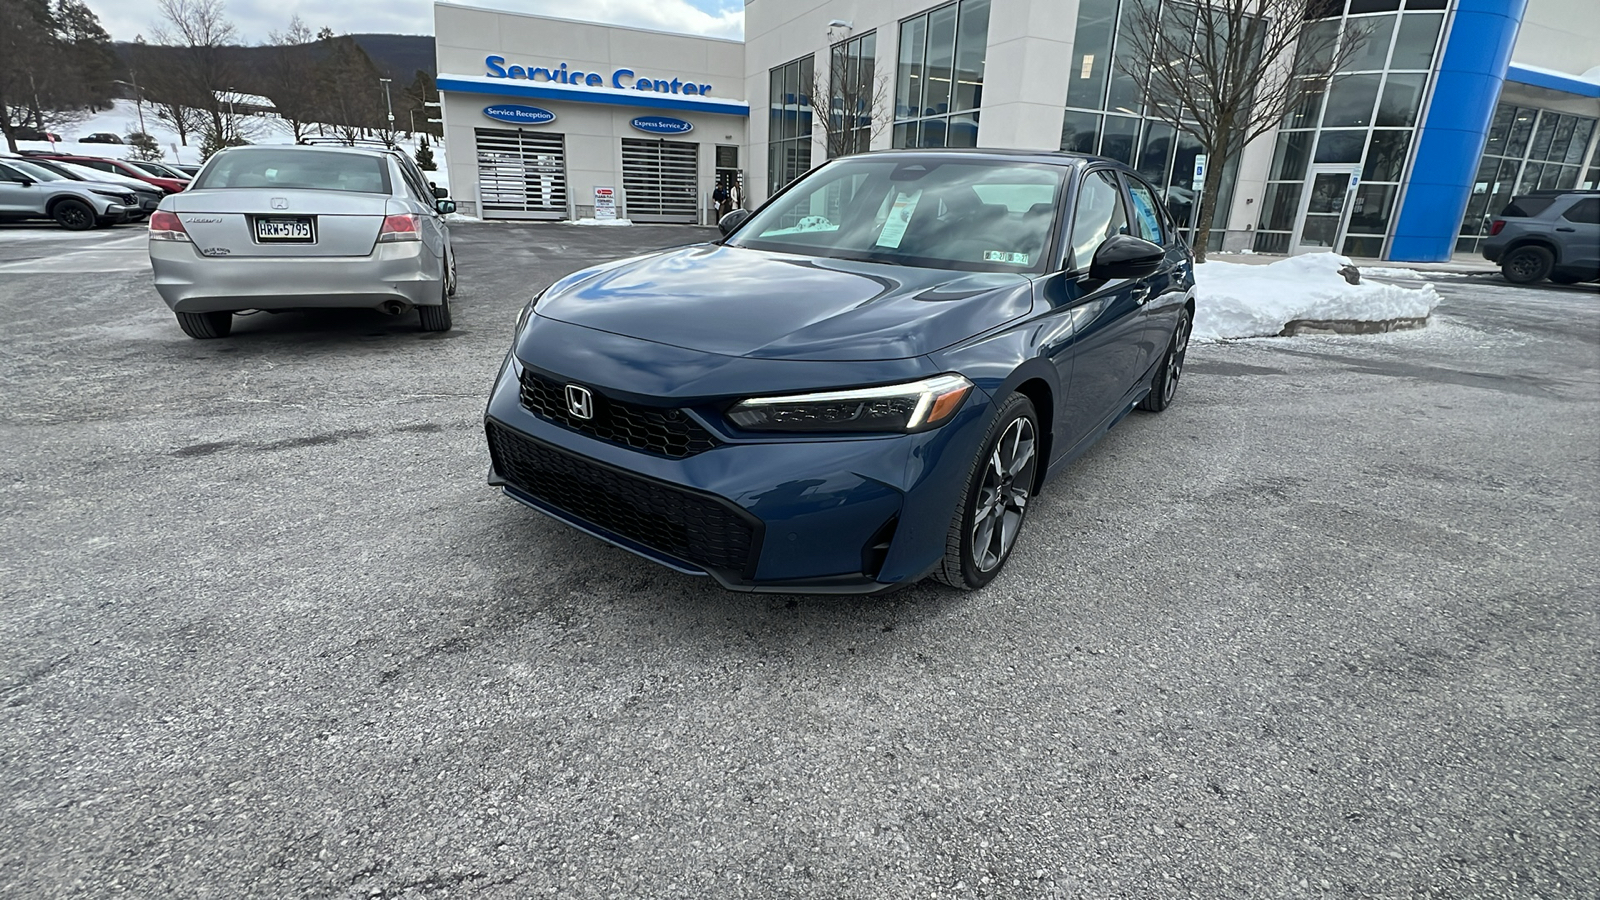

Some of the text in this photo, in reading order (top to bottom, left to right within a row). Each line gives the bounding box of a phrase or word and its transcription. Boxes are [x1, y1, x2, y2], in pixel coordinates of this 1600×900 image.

[485, 55, 712, 96] Service Center
[487, 107, 551, 120] Service Reception
[634, 119, 681, 129] Express Service
